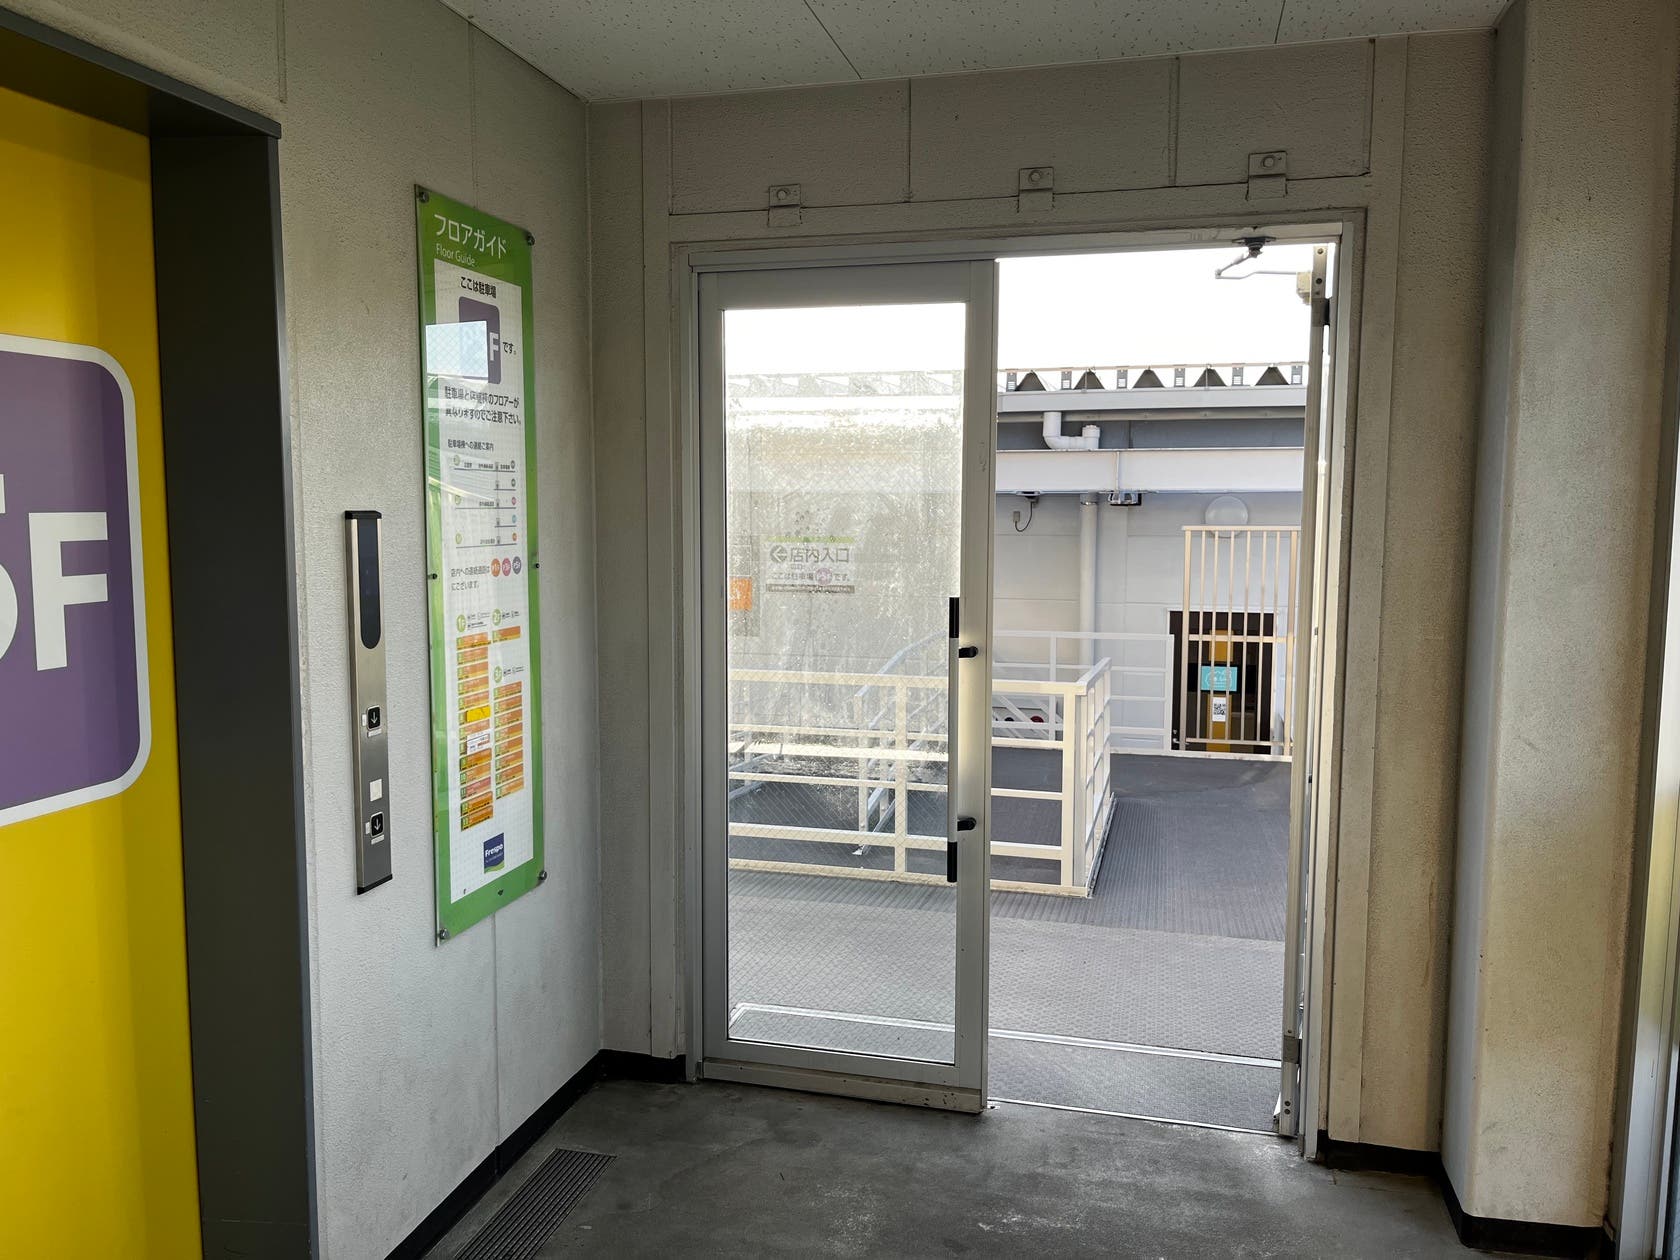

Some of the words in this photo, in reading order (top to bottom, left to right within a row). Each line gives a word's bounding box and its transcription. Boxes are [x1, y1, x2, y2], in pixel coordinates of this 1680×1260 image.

[434, 214, 507, 259] フロアガイド
[436, 243, 454, 259] Floor
[455, 250, 476, 267] Guide
[461, 276, 497, 298] ここは駐車場
[502, 341, 517, 356] です。
[790, 547, 850, 563] 店内入口
